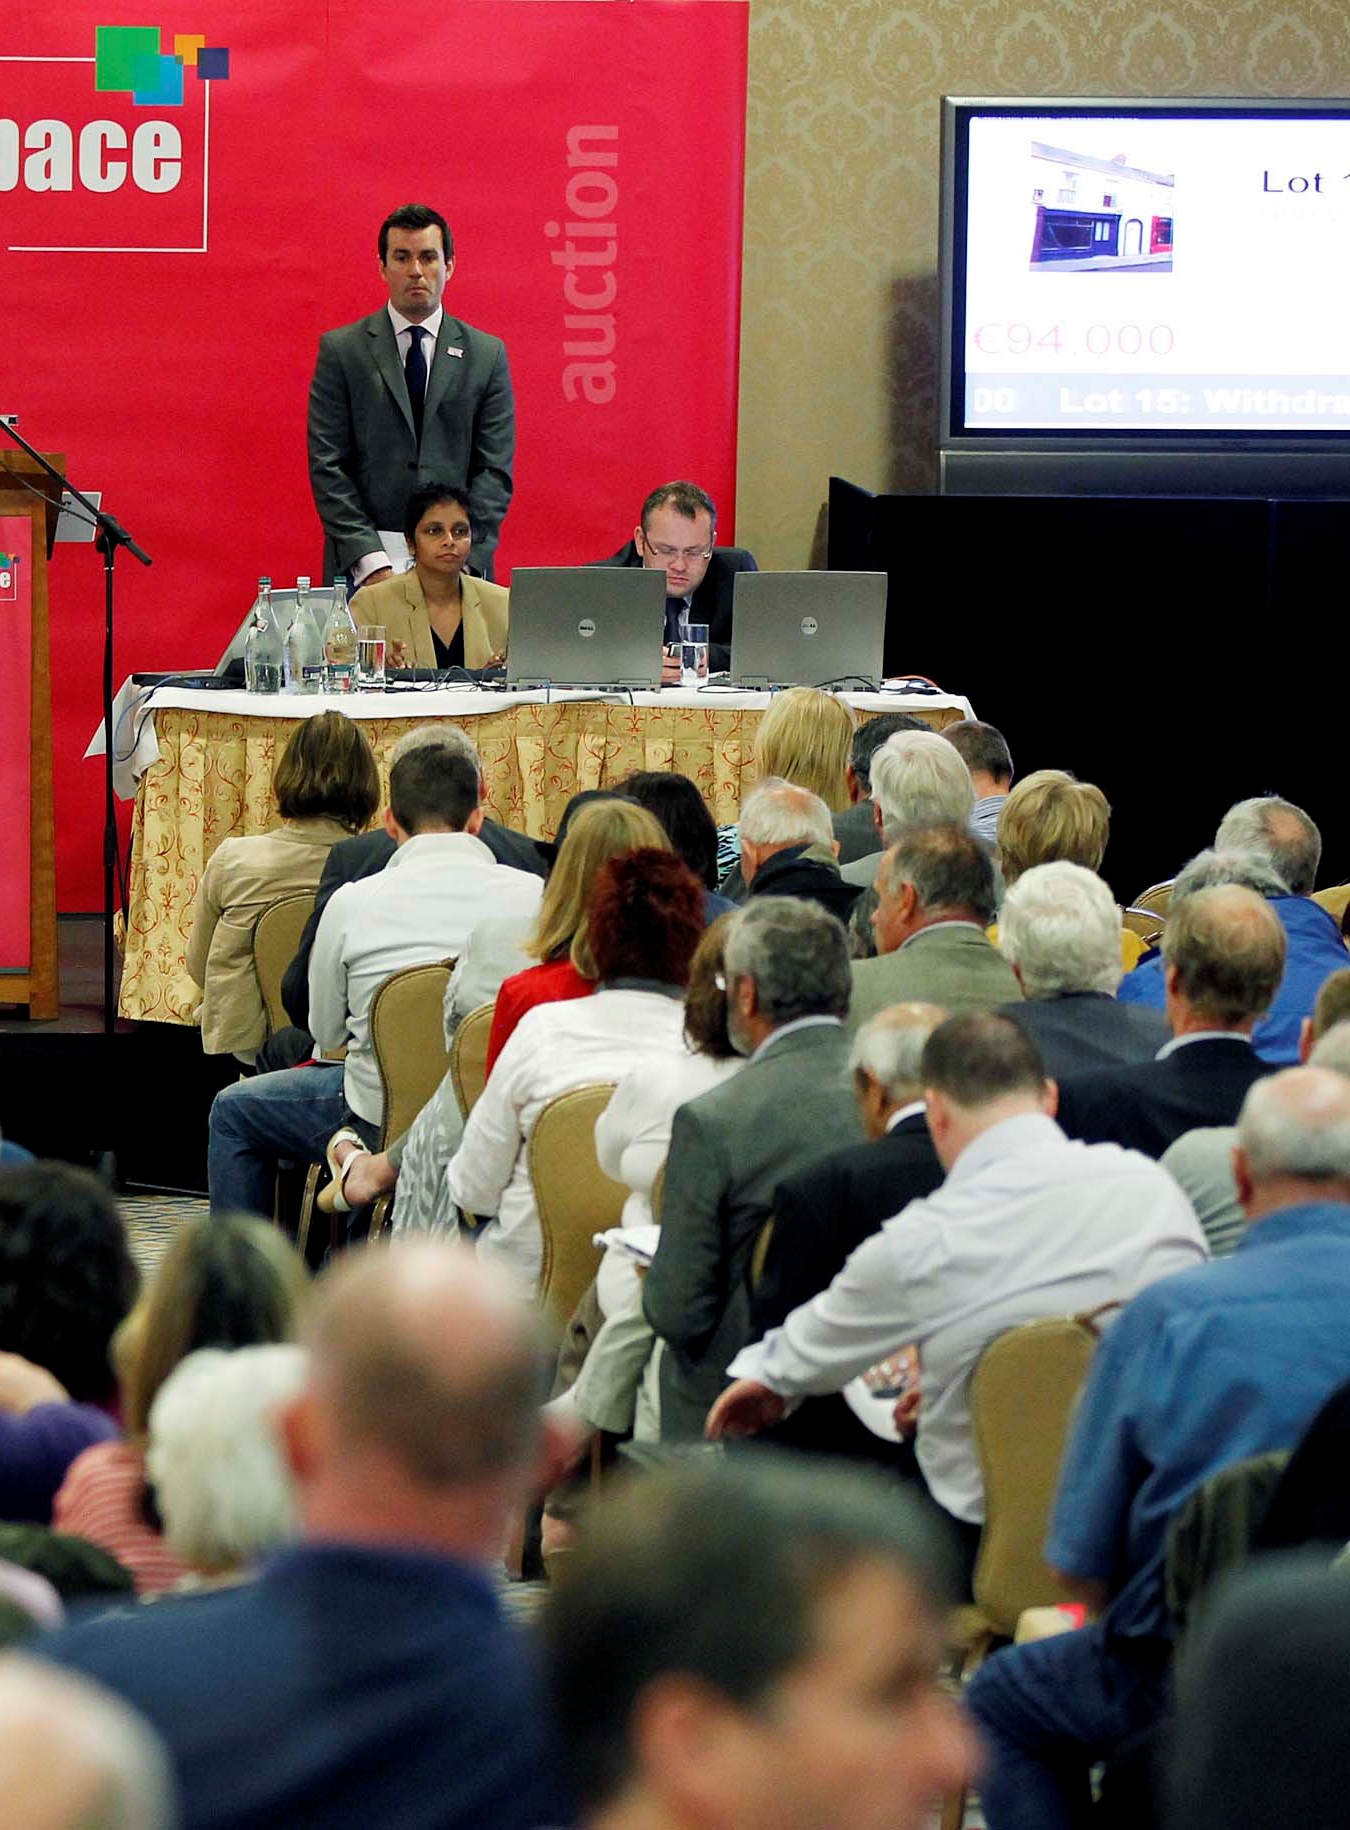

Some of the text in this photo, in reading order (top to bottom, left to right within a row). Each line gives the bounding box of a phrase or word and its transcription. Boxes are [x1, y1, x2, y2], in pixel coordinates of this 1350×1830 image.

[1263, 170, 1324, 193] Lot
[544, 124, 618, 404] auction
[1059, 387, 1122, 414] Lot
